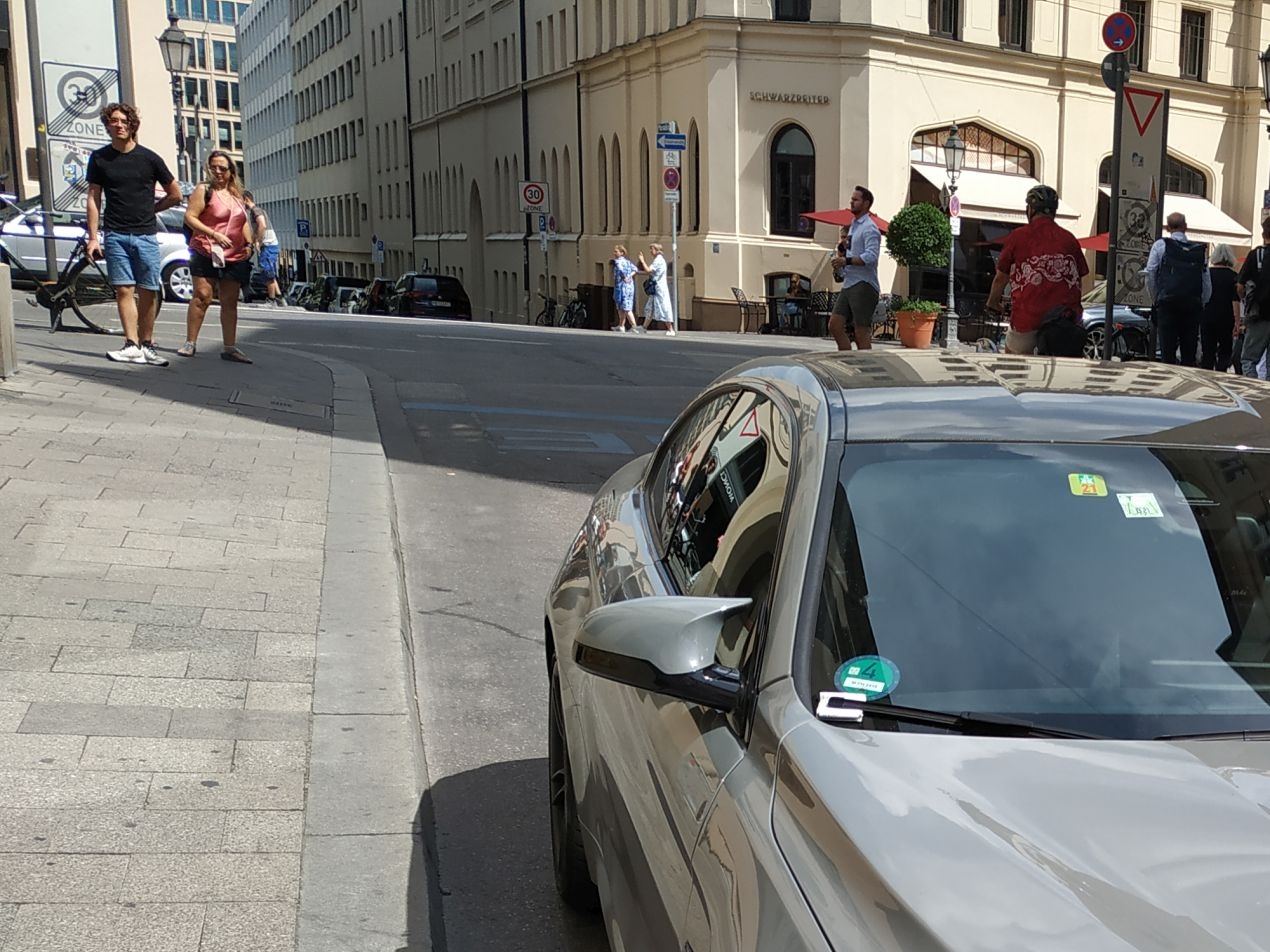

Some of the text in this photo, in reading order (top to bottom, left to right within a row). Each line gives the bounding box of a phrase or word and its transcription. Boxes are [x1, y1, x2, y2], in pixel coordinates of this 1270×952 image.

[749, 91, 831, 105] SCHWARZREITER
[66, 121, 104, 136] ZONE
[528, 189, 540, 199] 30
[1081, 483, 1097, 493] 21
[861, 661, 877, 679] 4
